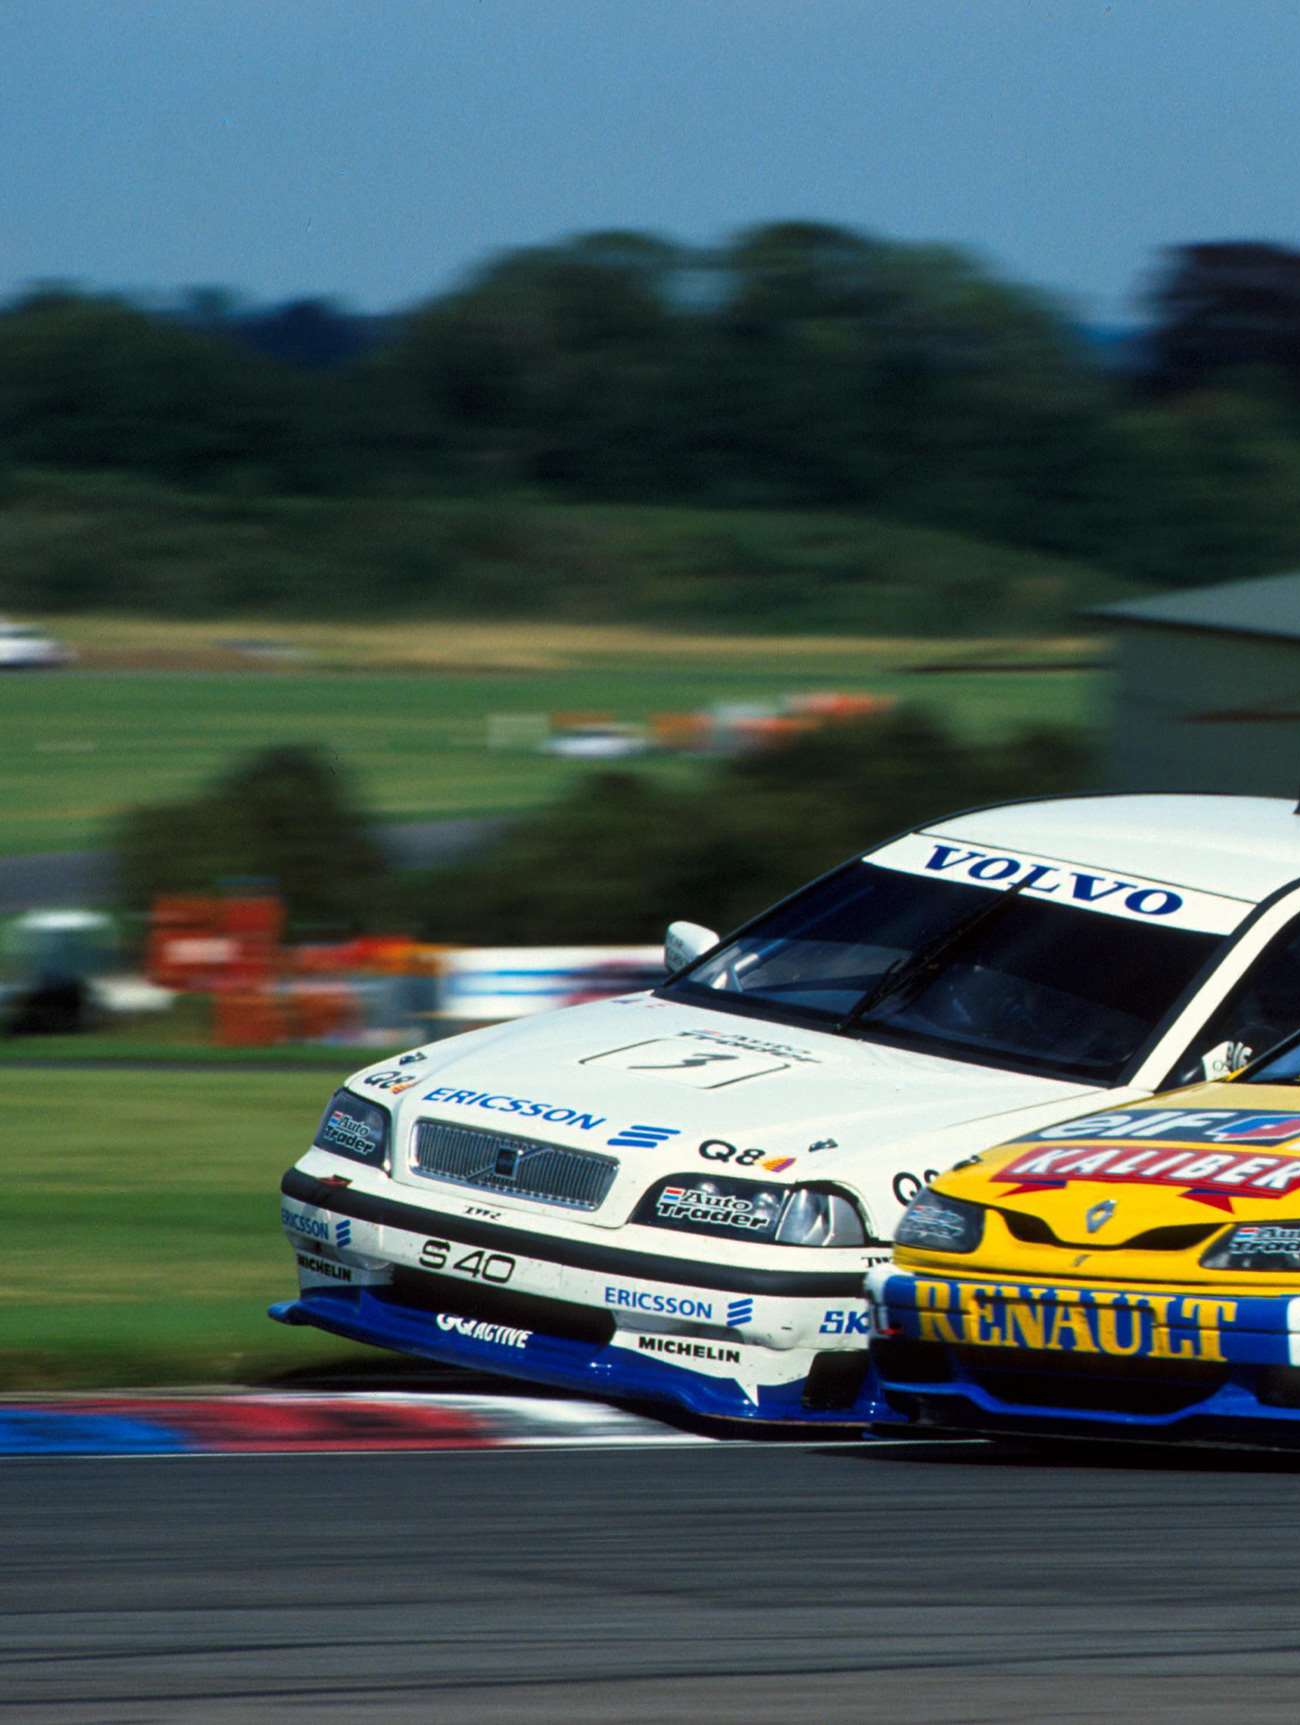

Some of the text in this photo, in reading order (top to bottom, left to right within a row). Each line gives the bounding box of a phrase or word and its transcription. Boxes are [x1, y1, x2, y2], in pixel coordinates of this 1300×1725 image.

[924, 844, 1184, 917] VOLVO
[363, 1070, 416, 1090] Q8
[421, 1087, 607, 1131] ERICSSON
[338, 1114, 372, 1138] Auto
[1037, 1110, 1238, 1139] elf
[324, 1124, 377, 1156] Trader
[699, 1139, 765, 1166] Q8
[681, 1189, 752, 1213] Auto
[656, 1201, 769, 1231] Trader
[296, 1252, 353, 1283] MICHELIN
[861, 1255, 893, 1268] TW
[604, 1286, 713, 1320] ERICSSON
[472, 1321, 534, 1349] ACTIVE
[818, 1309, 872, 1335] SK
[914, 1279, 1238, 1362] RENAULT
[638, 1335, 741, 1364] MICHELIN
